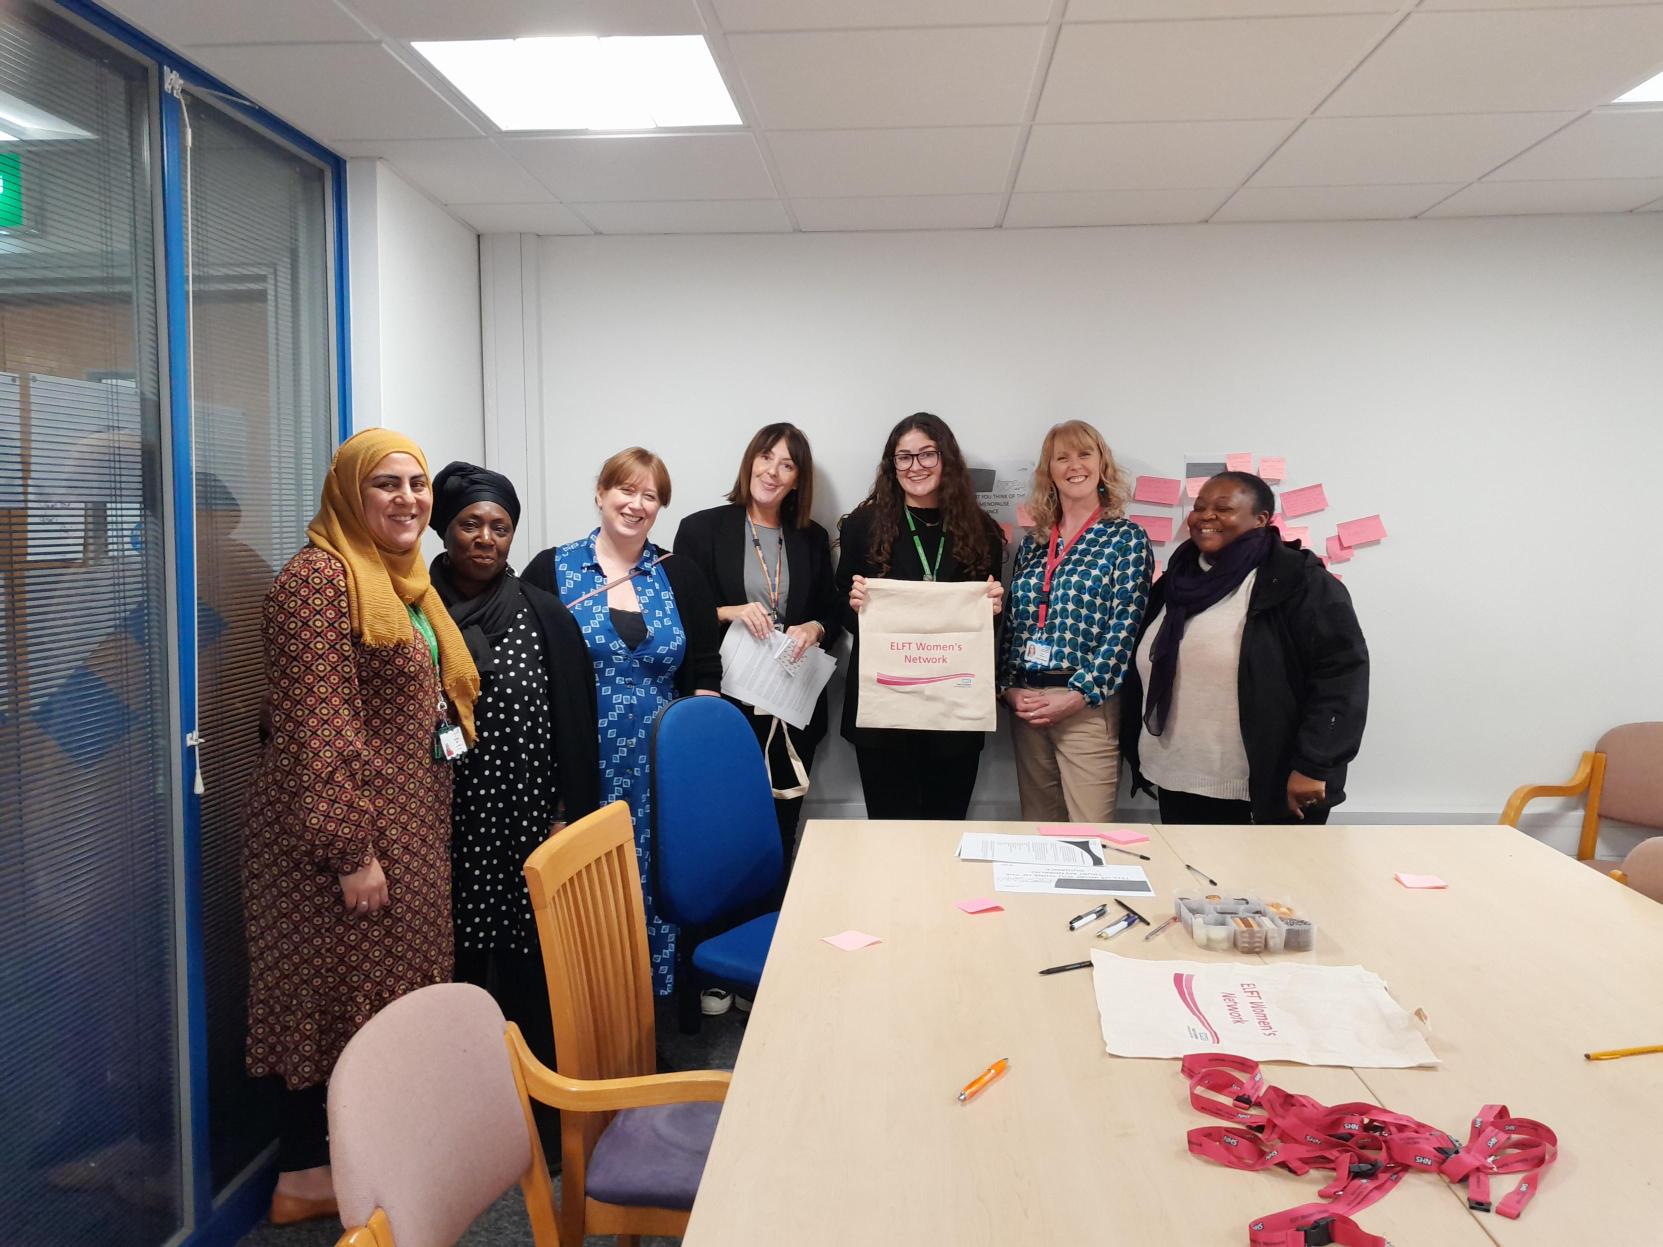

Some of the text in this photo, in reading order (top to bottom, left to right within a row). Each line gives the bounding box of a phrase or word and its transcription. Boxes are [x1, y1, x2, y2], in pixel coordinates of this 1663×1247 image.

[890, 641, 963, 652] ELFT Women's
[904, 654, 948, 664] Network
[1220, 991, 1249, 1025] Network
[1240, 983, 1278, 1037] ELFT Women's
[1343, 1122, 1360, 1131] NHS
[1414, 1155, 1432, 1166] NHS
